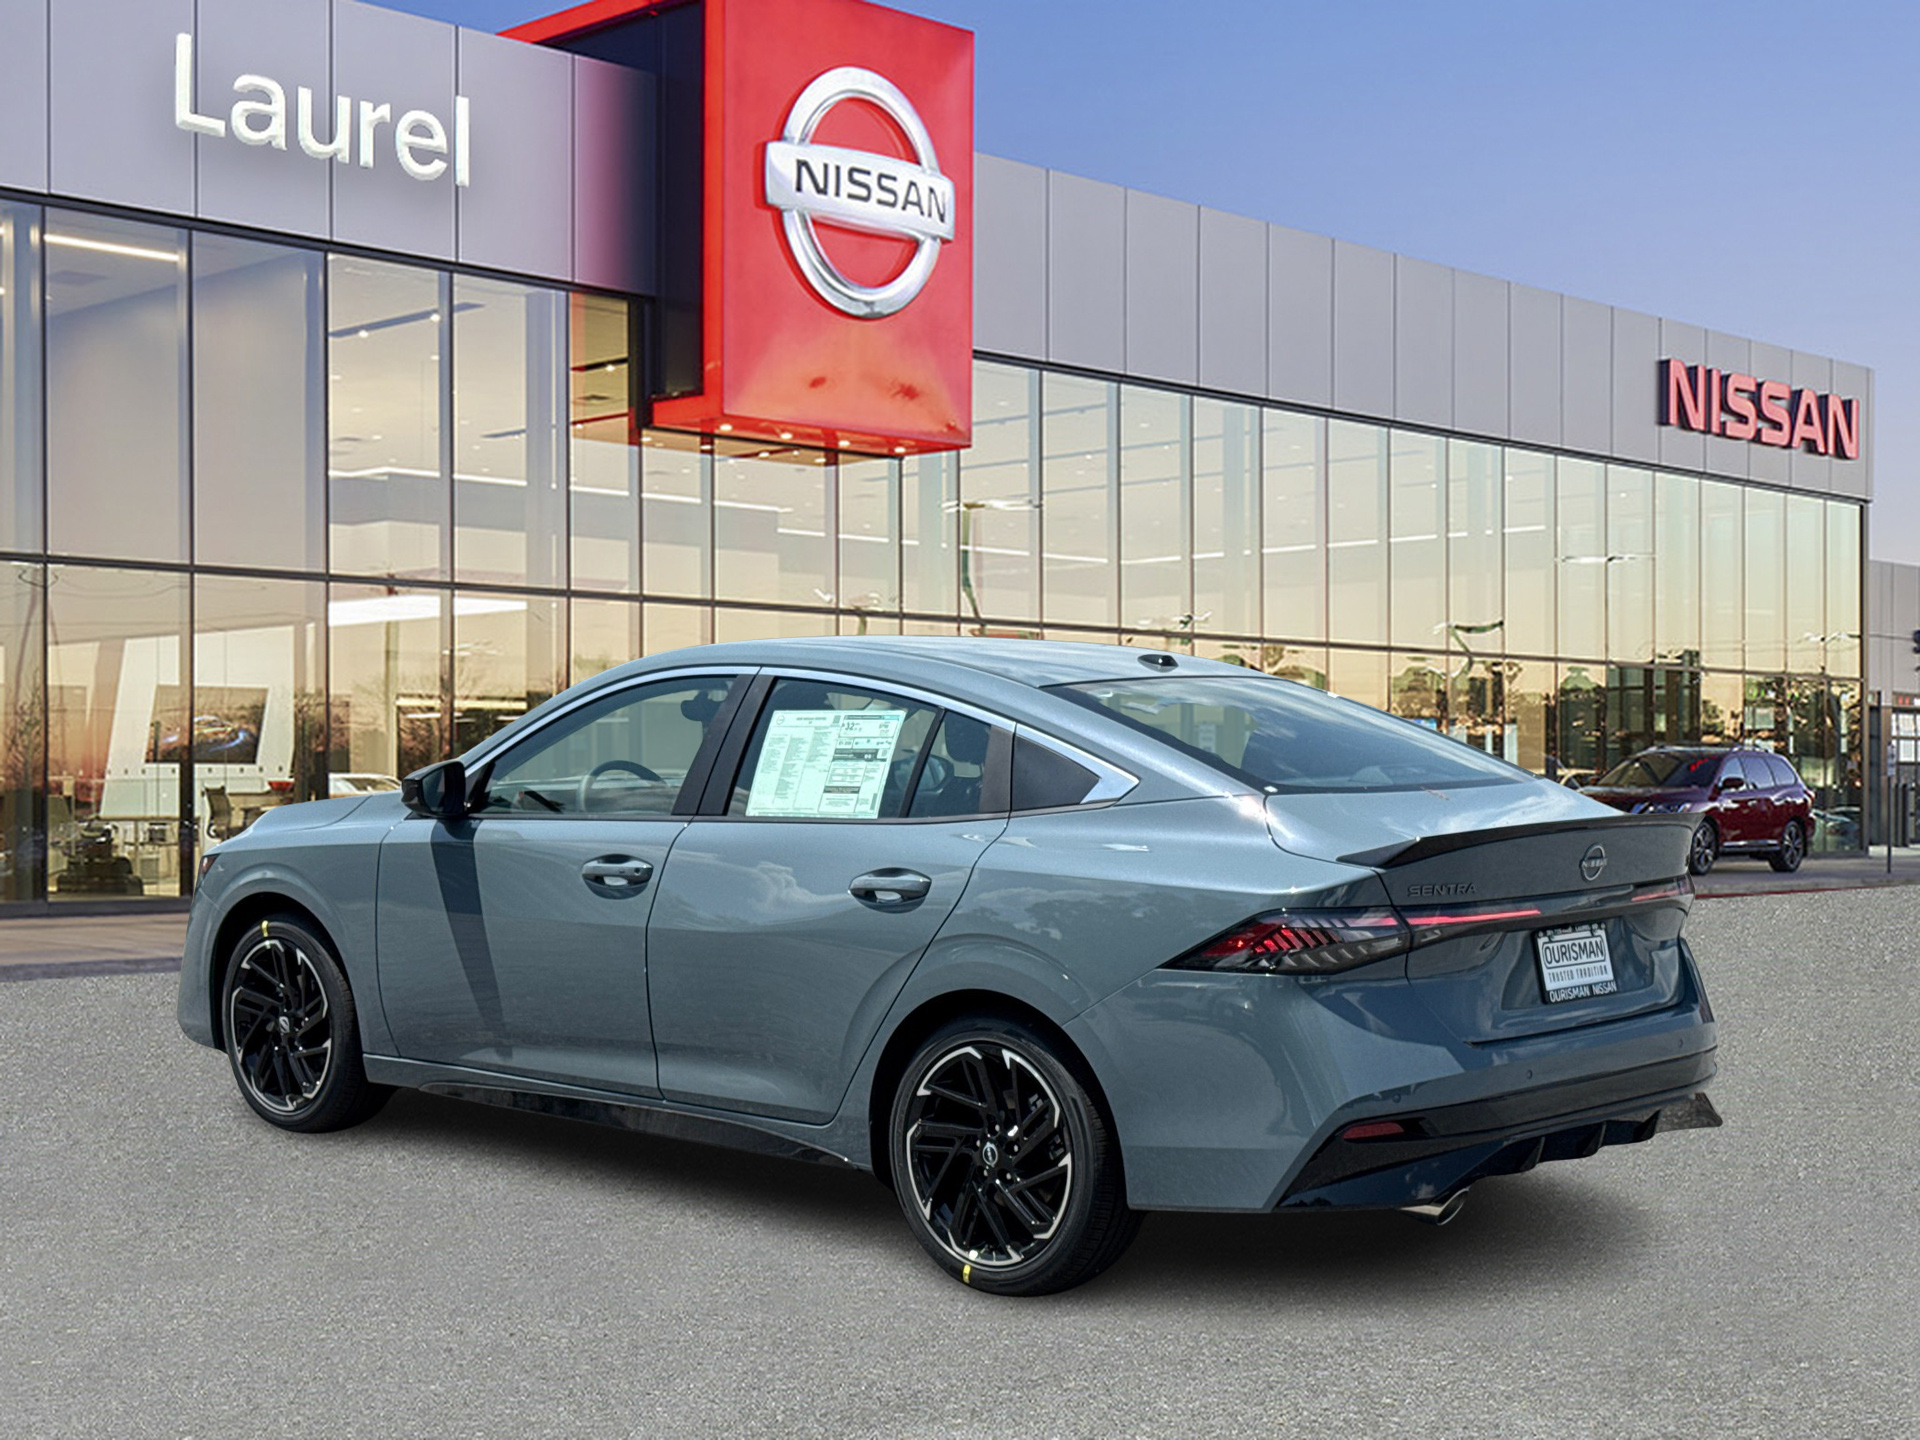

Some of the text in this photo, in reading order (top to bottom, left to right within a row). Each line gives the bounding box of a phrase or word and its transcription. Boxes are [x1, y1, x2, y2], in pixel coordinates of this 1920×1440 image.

[175, 32, 470, 188] Laurel
[795, 158, 946, 224] NISSAN
[1659, 358, 1860, 460] NISSAN
[1407, 883, 1477, 897] SENTRA
[1544, 939, 1605, 965] OURISMAN
[1548, 964, 1608, 983] TRUSTED TRADITION
[1549, 980, 1618, 1003] OURISMAN NISSAN
